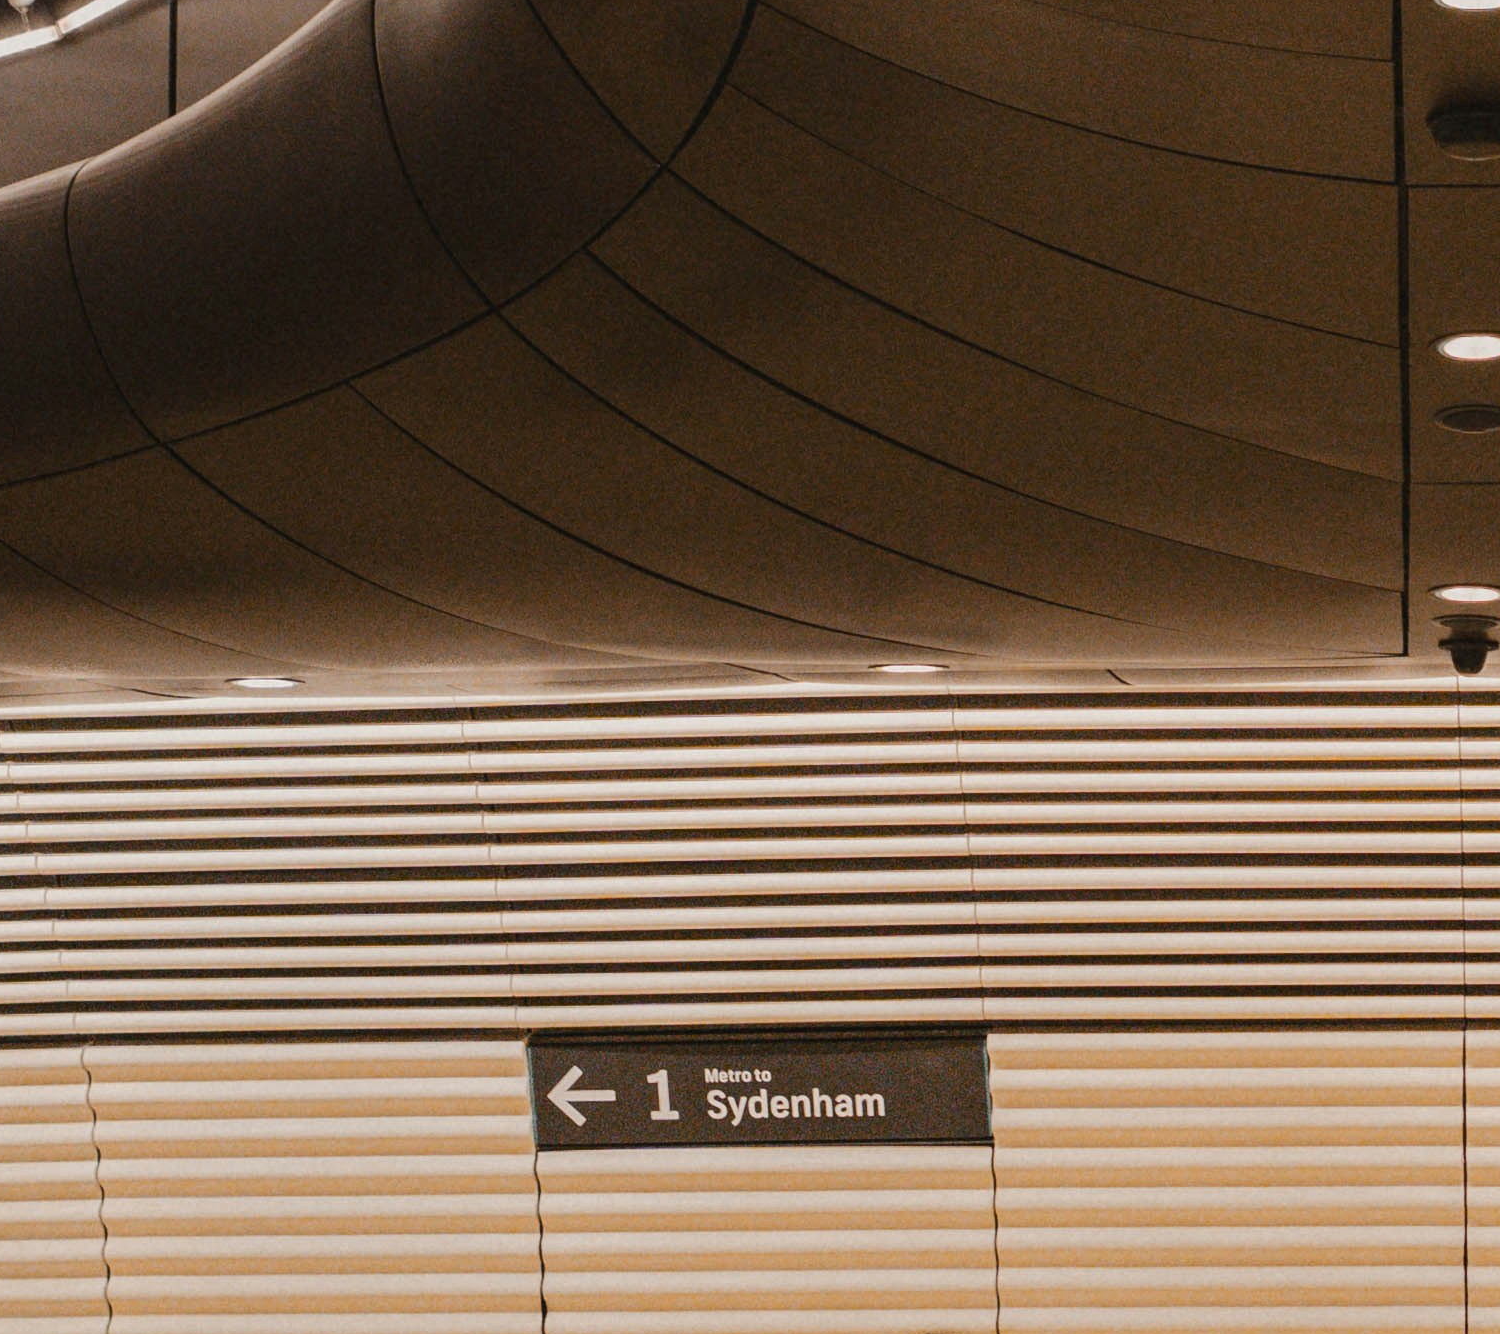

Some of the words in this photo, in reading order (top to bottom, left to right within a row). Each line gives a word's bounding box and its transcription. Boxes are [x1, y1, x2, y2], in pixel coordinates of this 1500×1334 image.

[645, 1069, 680, 1121] 1
[704, 1067, 750, 1084] Metro
[752, 1067, 772, 1083] to
[706, 1086, 886, 1127] Sydenham
